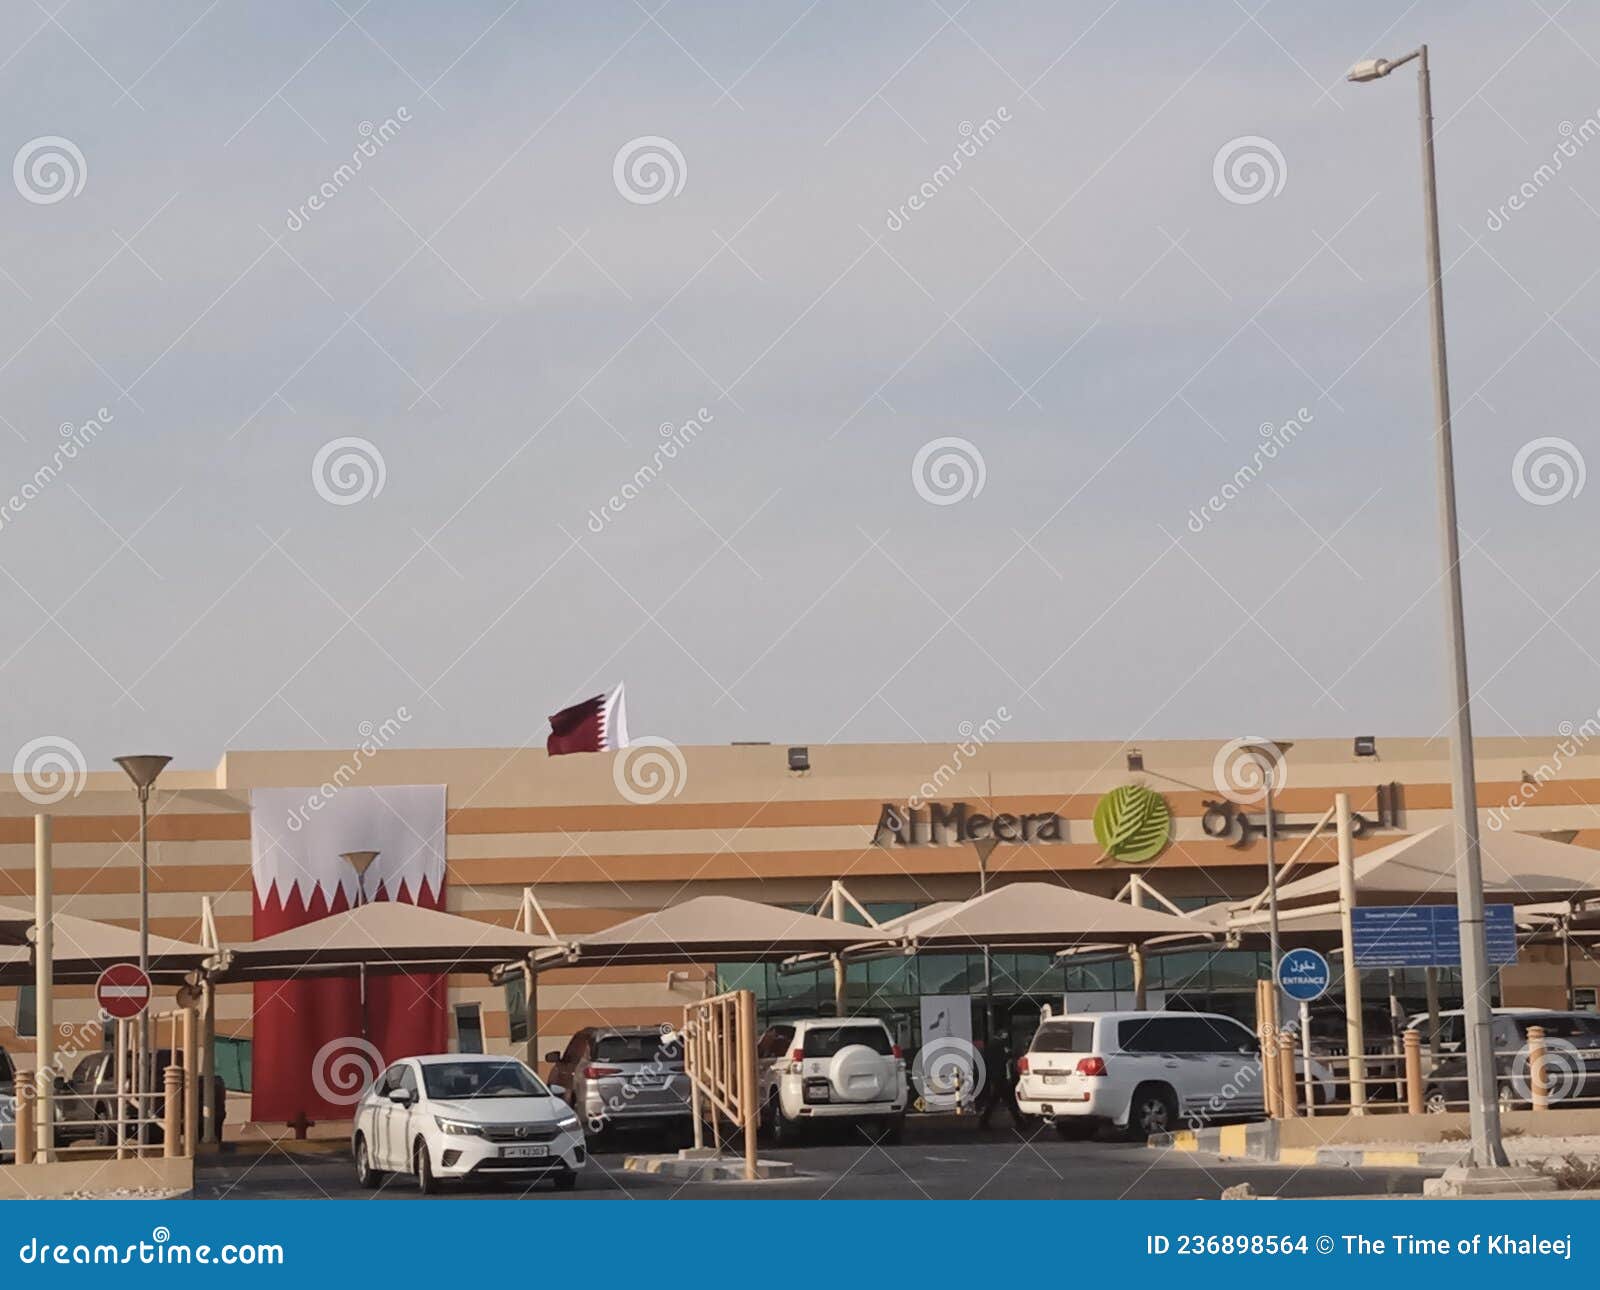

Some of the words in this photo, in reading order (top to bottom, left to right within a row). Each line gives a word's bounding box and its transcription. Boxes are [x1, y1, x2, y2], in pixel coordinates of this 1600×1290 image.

[872, 802, 919, 845] Al
[928, 802, 1064, 844] Meera
[1290, 959, 1316, 974] دخول
[1282, 976, 1325, 985] ENTRANCE
